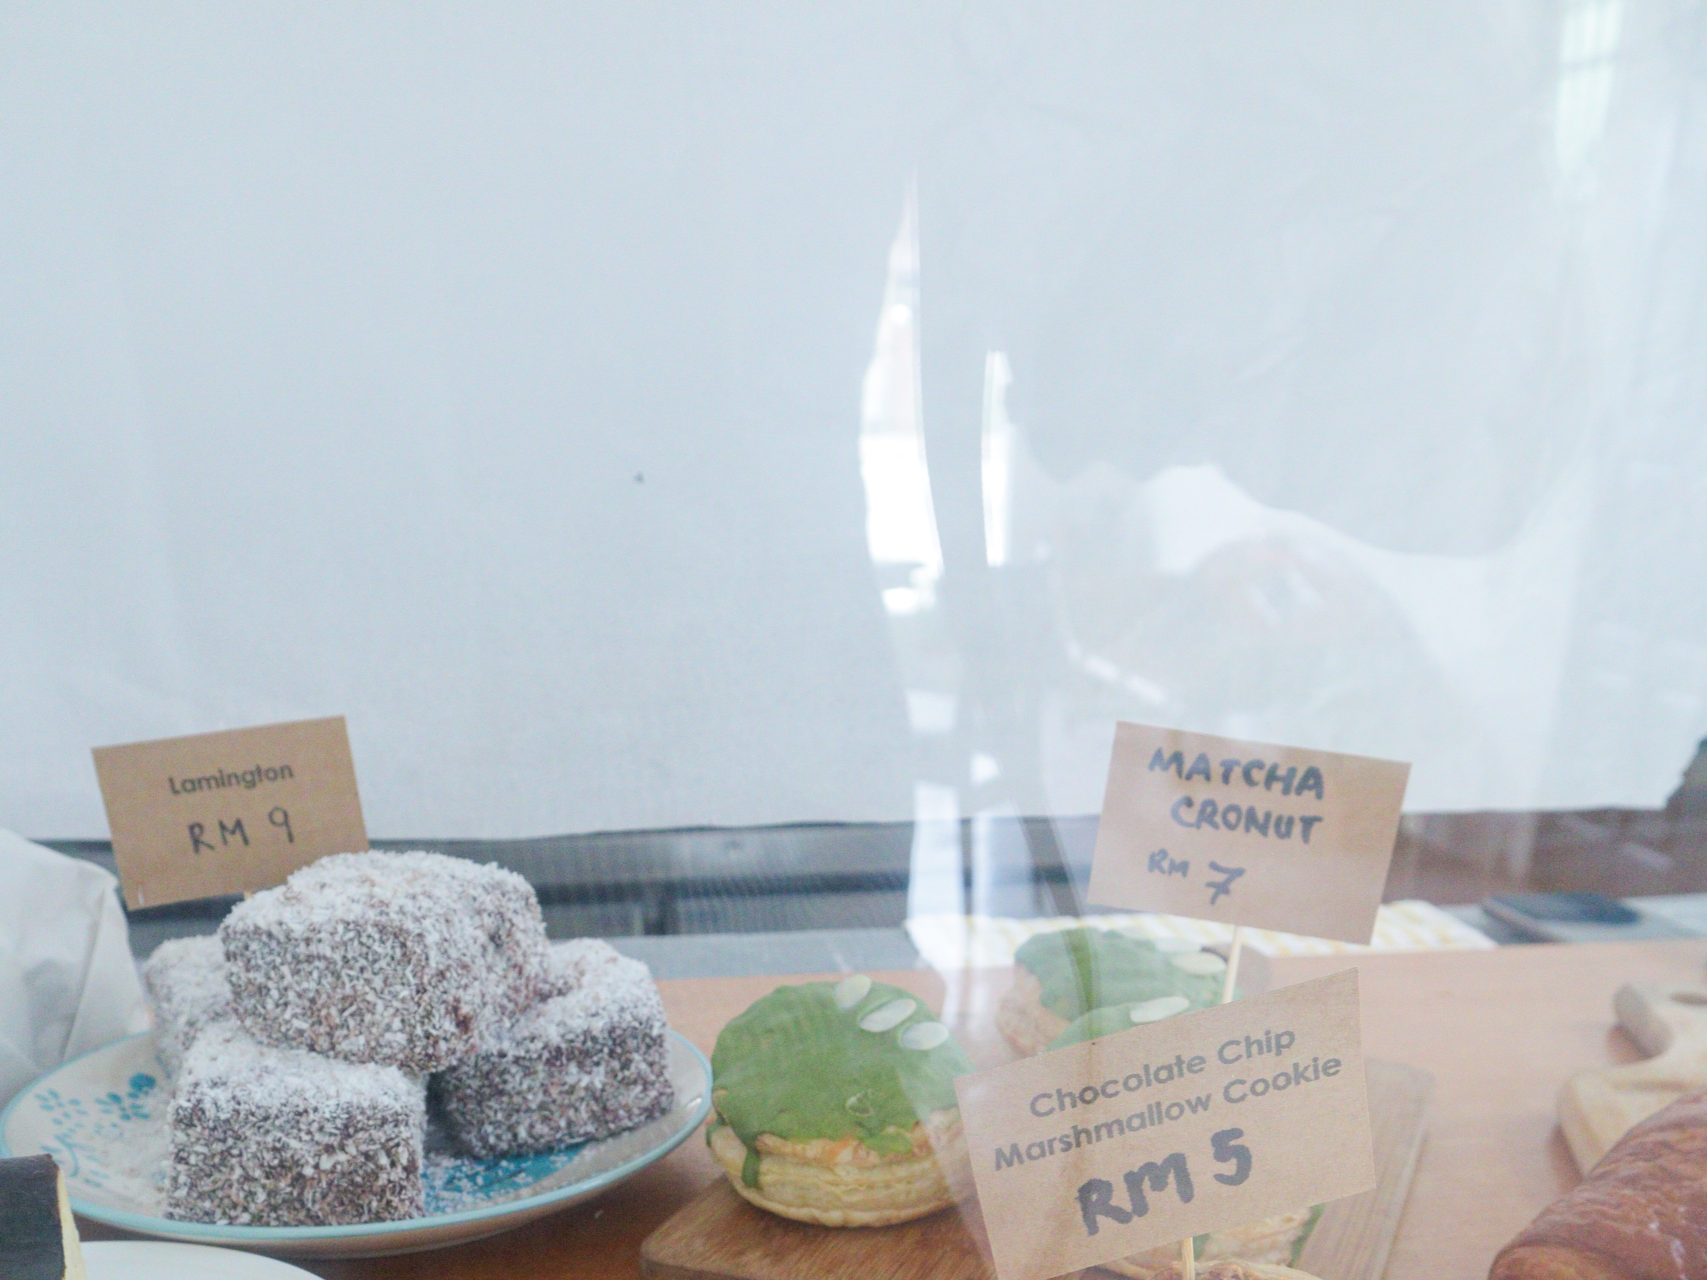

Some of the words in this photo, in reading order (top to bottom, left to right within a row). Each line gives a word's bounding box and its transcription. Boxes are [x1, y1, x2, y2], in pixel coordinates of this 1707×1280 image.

[169, 764, 294, 795] Lamington
[1148, 747, 1324, 800] MATCHA
[188, 818, 249, 854] RM
[267, 806, 295, 843] 9
[1170, 795, 1324, 844] CRONUT
[1147, 848, 1190, 878] RM
[1205, 860, 1246, 905] 7
[1029, 1053, 1206, 1118] Chocolate
[1217, 1029, 1296, 1066] Chip
[994, 1092, 1212, 1171] Marshmallow
[1222, 1056, 1342, 1104] Cookie
[1075, 1152, 1195, 1236] RM
[1210, 1127, 1252, 1187] 5
